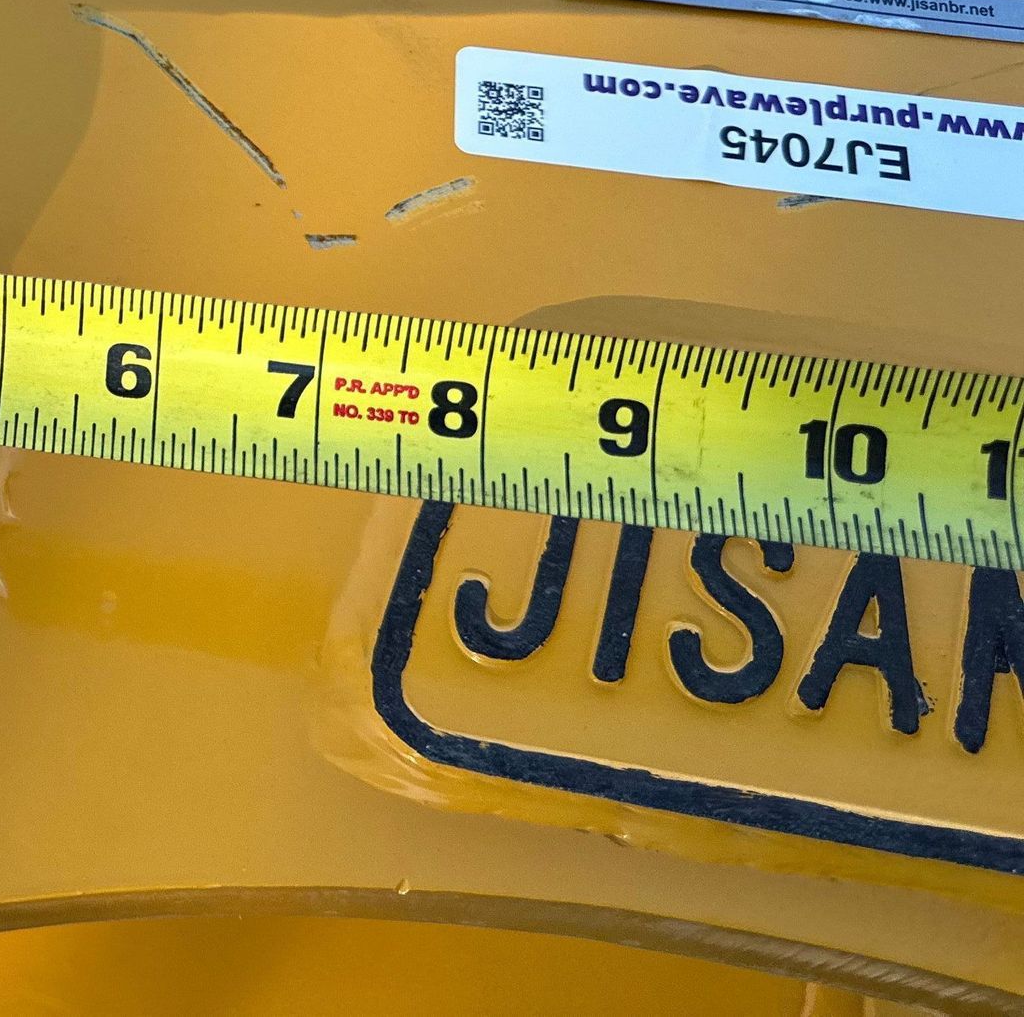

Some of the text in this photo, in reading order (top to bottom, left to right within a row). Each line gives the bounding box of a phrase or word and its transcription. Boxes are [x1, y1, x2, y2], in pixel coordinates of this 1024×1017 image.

[719, 125, 911, 182] EJ7045
[106, 342, 152, 399] 6
[267, 361, 316, 419] 7
[334, 377, 366, 394] P.R.
[333, 403, 362, 419] NO.
[367, 407, 394, 422] 339
[428, 380, 479, 439] 8
[598, 398, 651, 457] 9
[799, 419, 888, 484] 10
[980, 439, 1024, 500] 1
